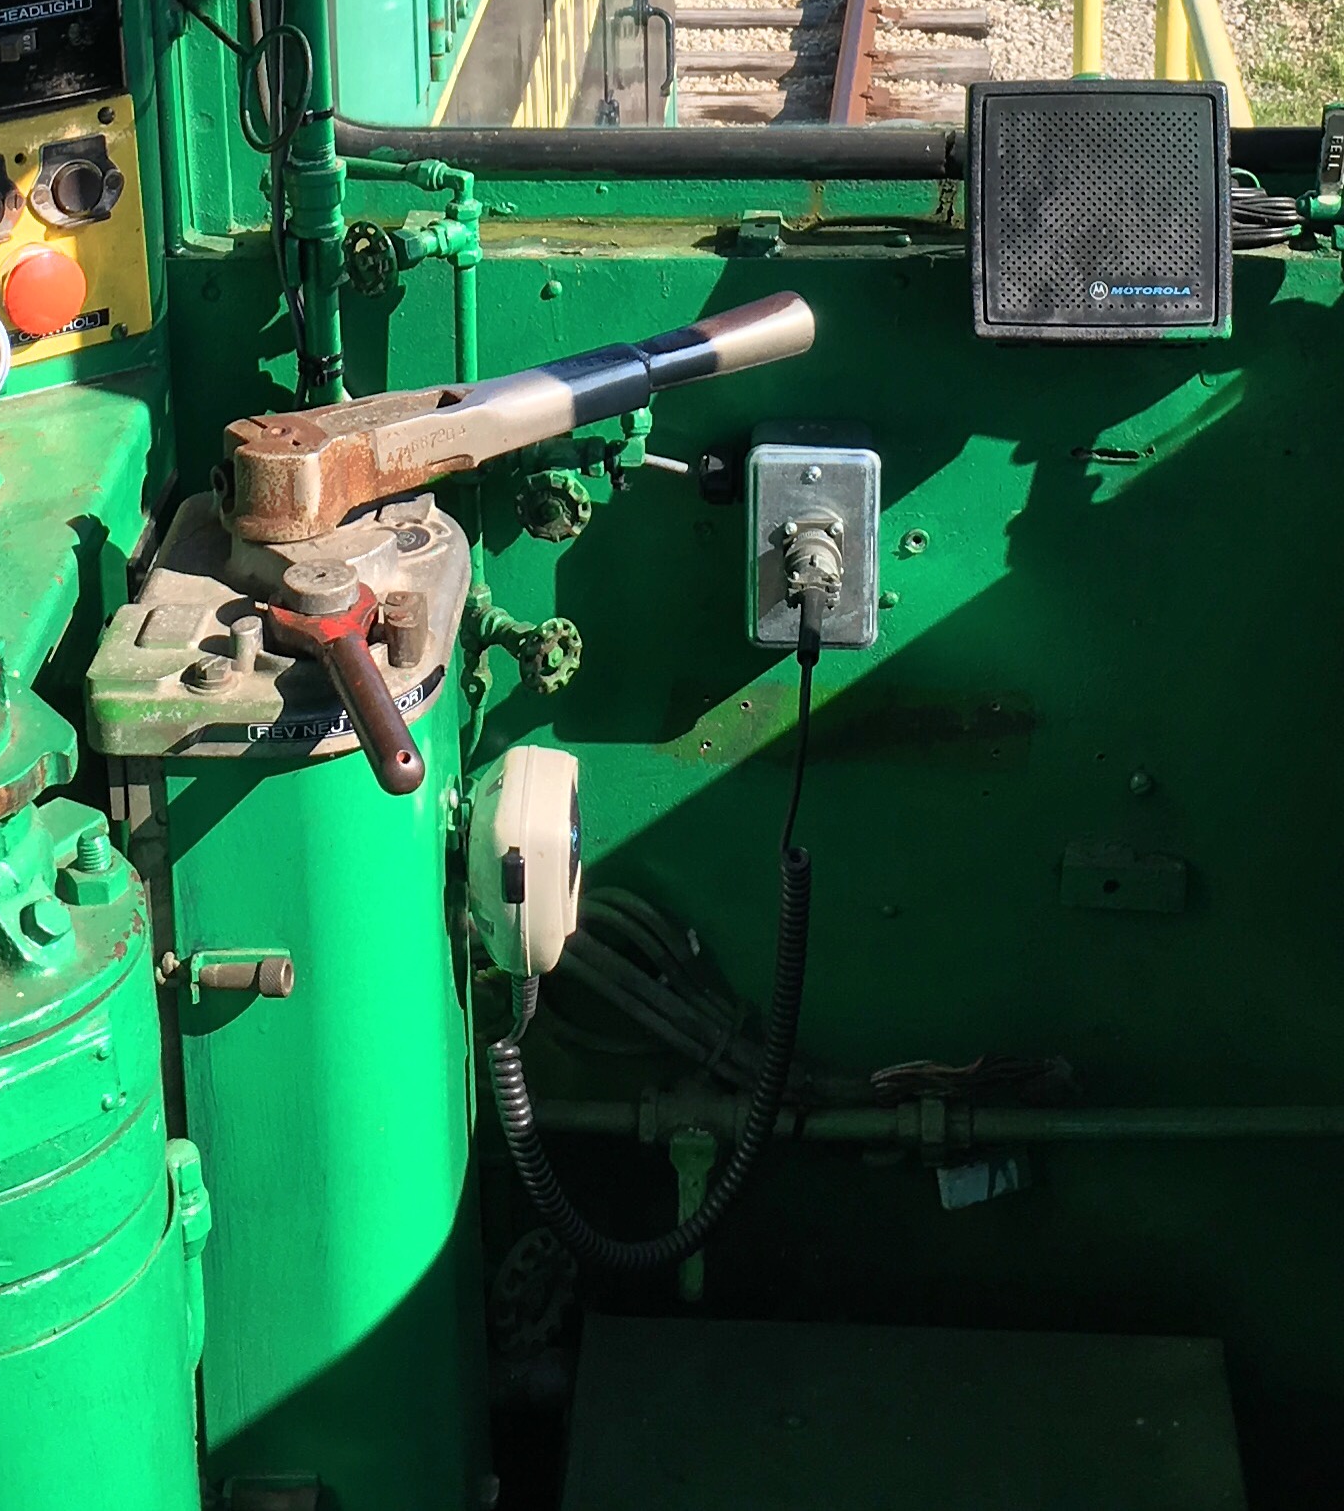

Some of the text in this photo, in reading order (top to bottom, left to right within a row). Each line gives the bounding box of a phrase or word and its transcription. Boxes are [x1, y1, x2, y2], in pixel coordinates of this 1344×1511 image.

[1111, 286, 1191, 295] MOTOROLA
[256, 690, 419, 740] REV NEU OR
